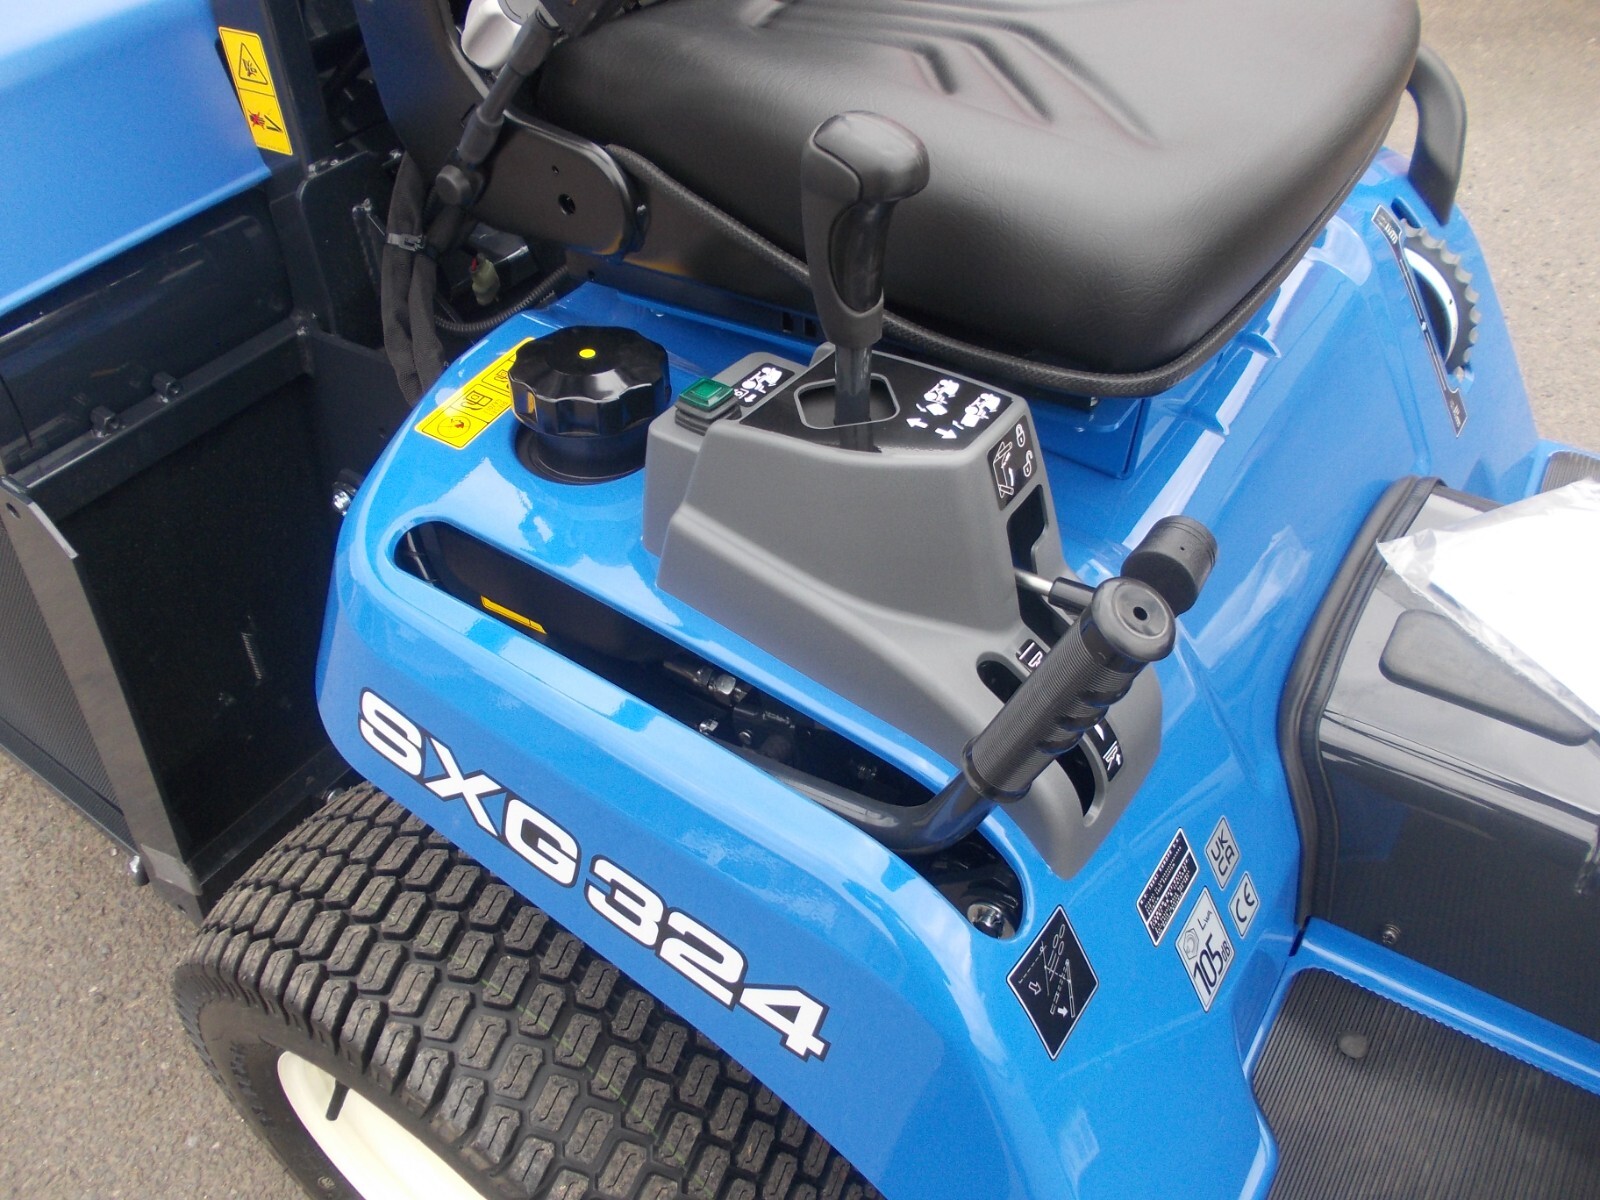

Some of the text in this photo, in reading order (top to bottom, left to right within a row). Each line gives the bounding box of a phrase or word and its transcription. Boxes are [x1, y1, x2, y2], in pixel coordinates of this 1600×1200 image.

[1211, 829, 1229, 861] UK
[359, 688, 829, 1061] SXG 324
[1235, 882, 1255, 923] CE
[1194, 933, 1231, 996] 105 dB
